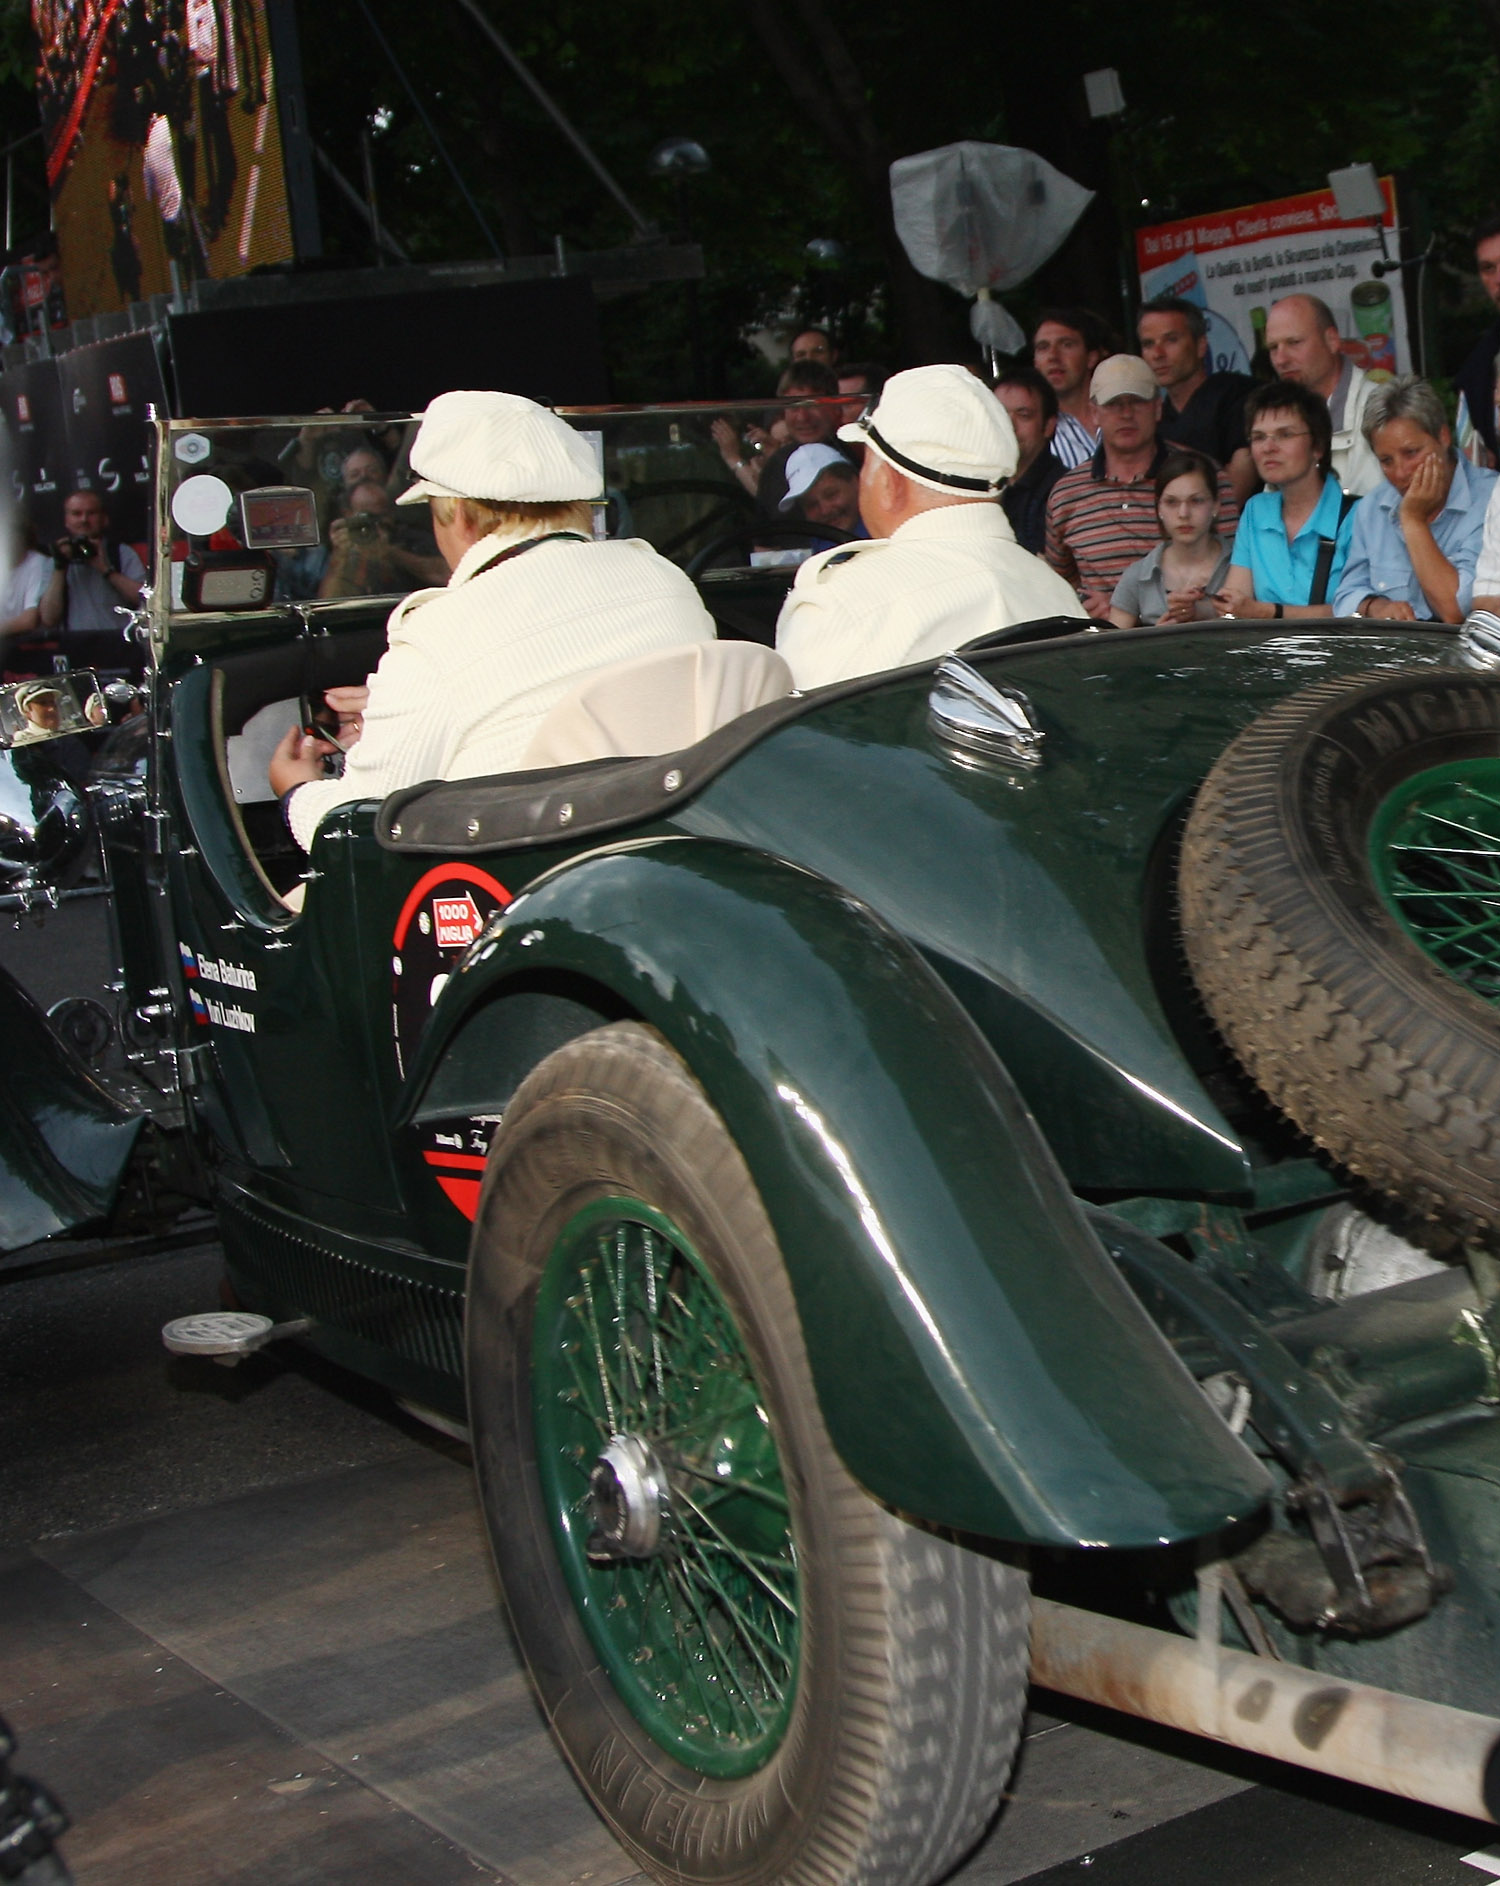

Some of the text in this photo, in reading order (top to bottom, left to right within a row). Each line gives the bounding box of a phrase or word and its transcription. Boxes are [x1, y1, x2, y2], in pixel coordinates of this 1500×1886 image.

[1161, 234, 1173, 250] 15
[1235, 217, 1268, 237] Cliente
[438, 904, 469, 920] 1000
[589, 1735, 769, 1858] MICHELIN
